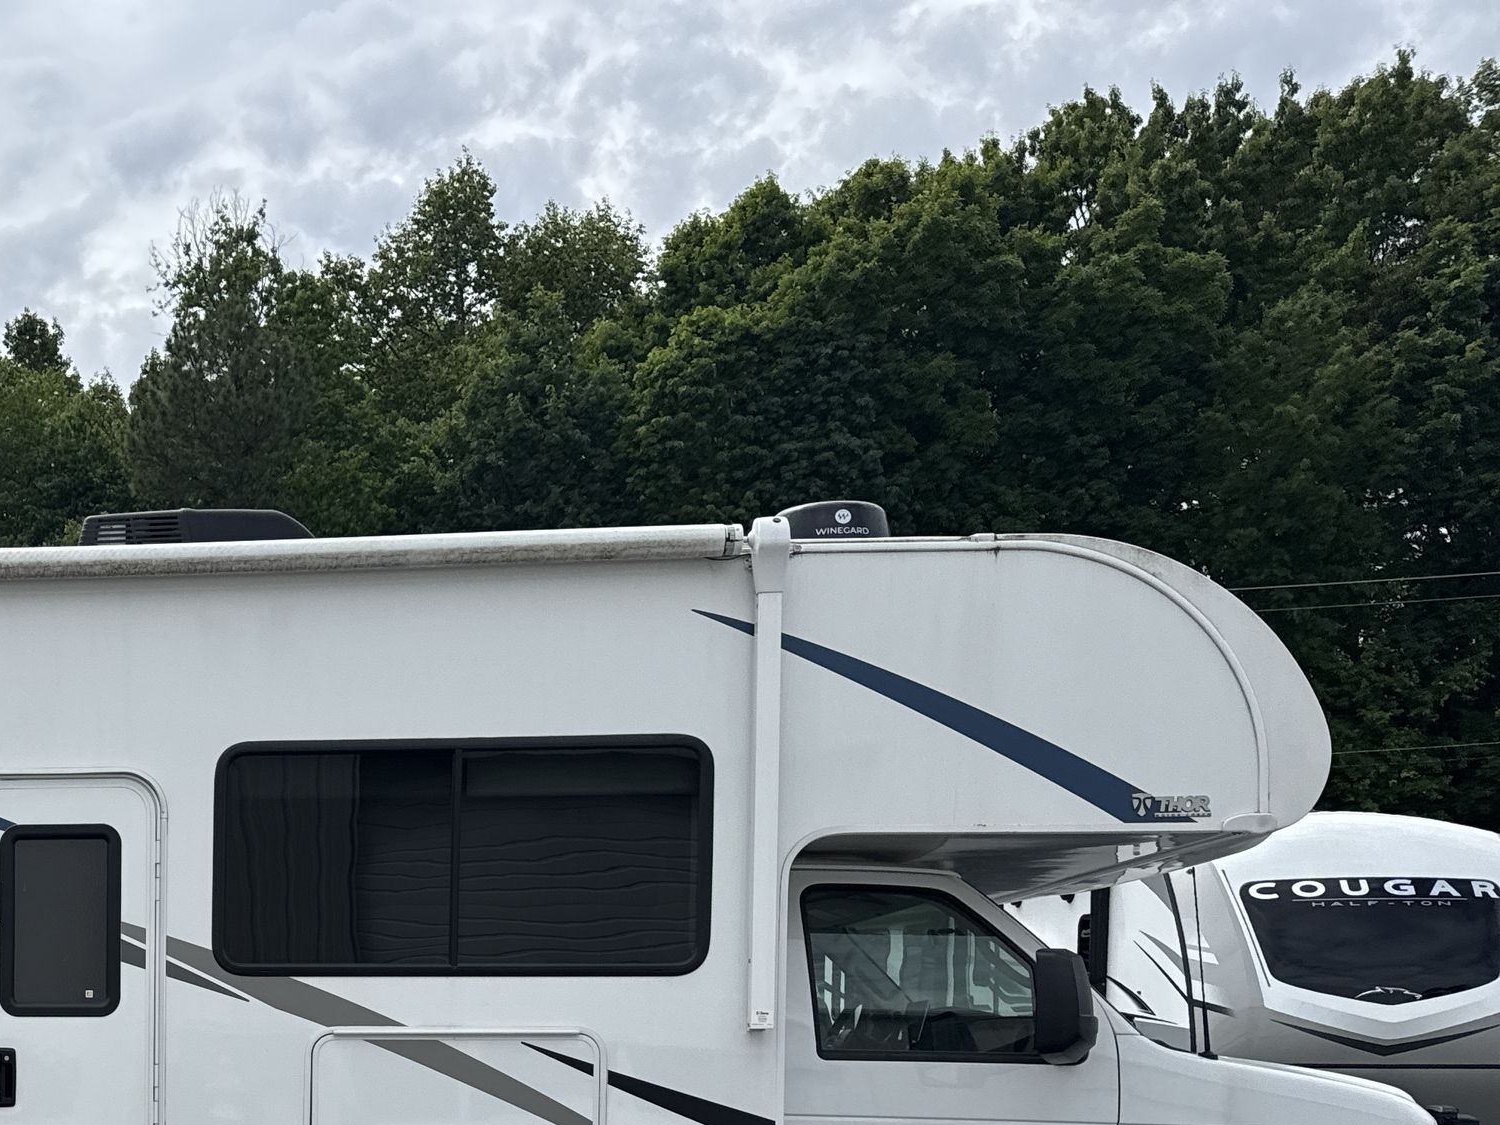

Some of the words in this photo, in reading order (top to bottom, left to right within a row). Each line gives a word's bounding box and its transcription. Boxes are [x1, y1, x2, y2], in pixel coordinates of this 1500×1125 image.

[815, 526, 870, 536] WINEGARD
[1154, 795, 1212, 813] THOR
[1249, 879, 1500, 899] COUGAR
